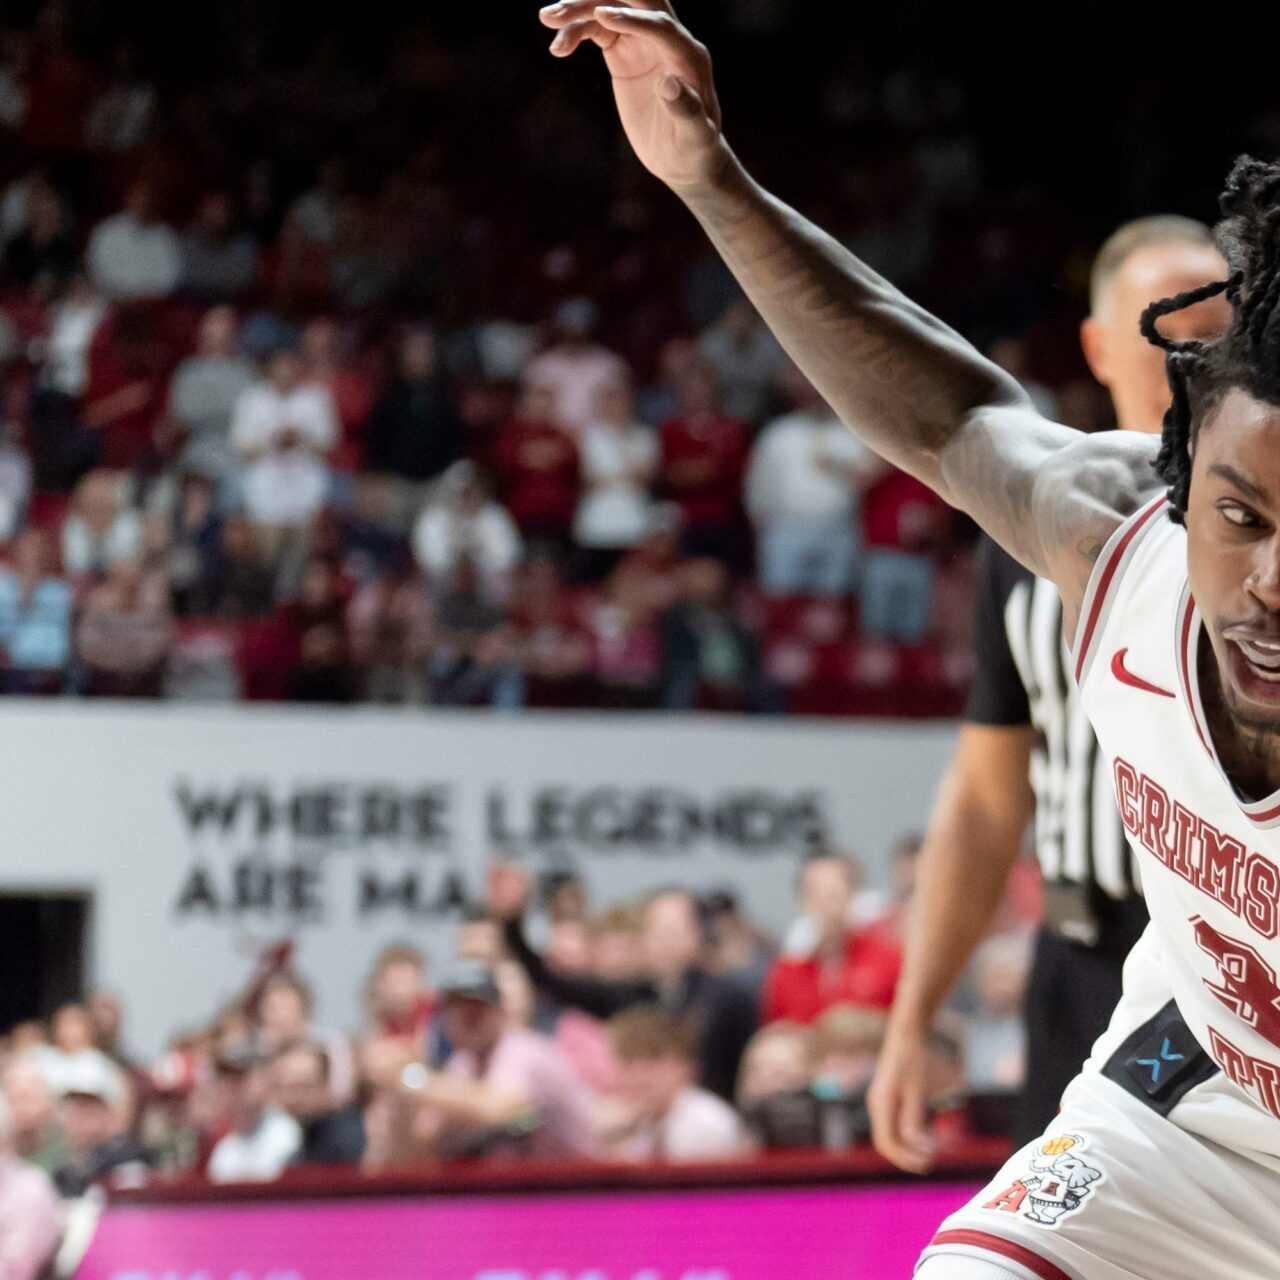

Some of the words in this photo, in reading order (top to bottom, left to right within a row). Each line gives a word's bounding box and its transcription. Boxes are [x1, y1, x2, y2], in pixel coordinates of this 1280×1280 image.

[177, 783, 450, 846] WHERE
[486, 786, 827, 860] LEGENDS
[178, 859, 324, 920] ARE
